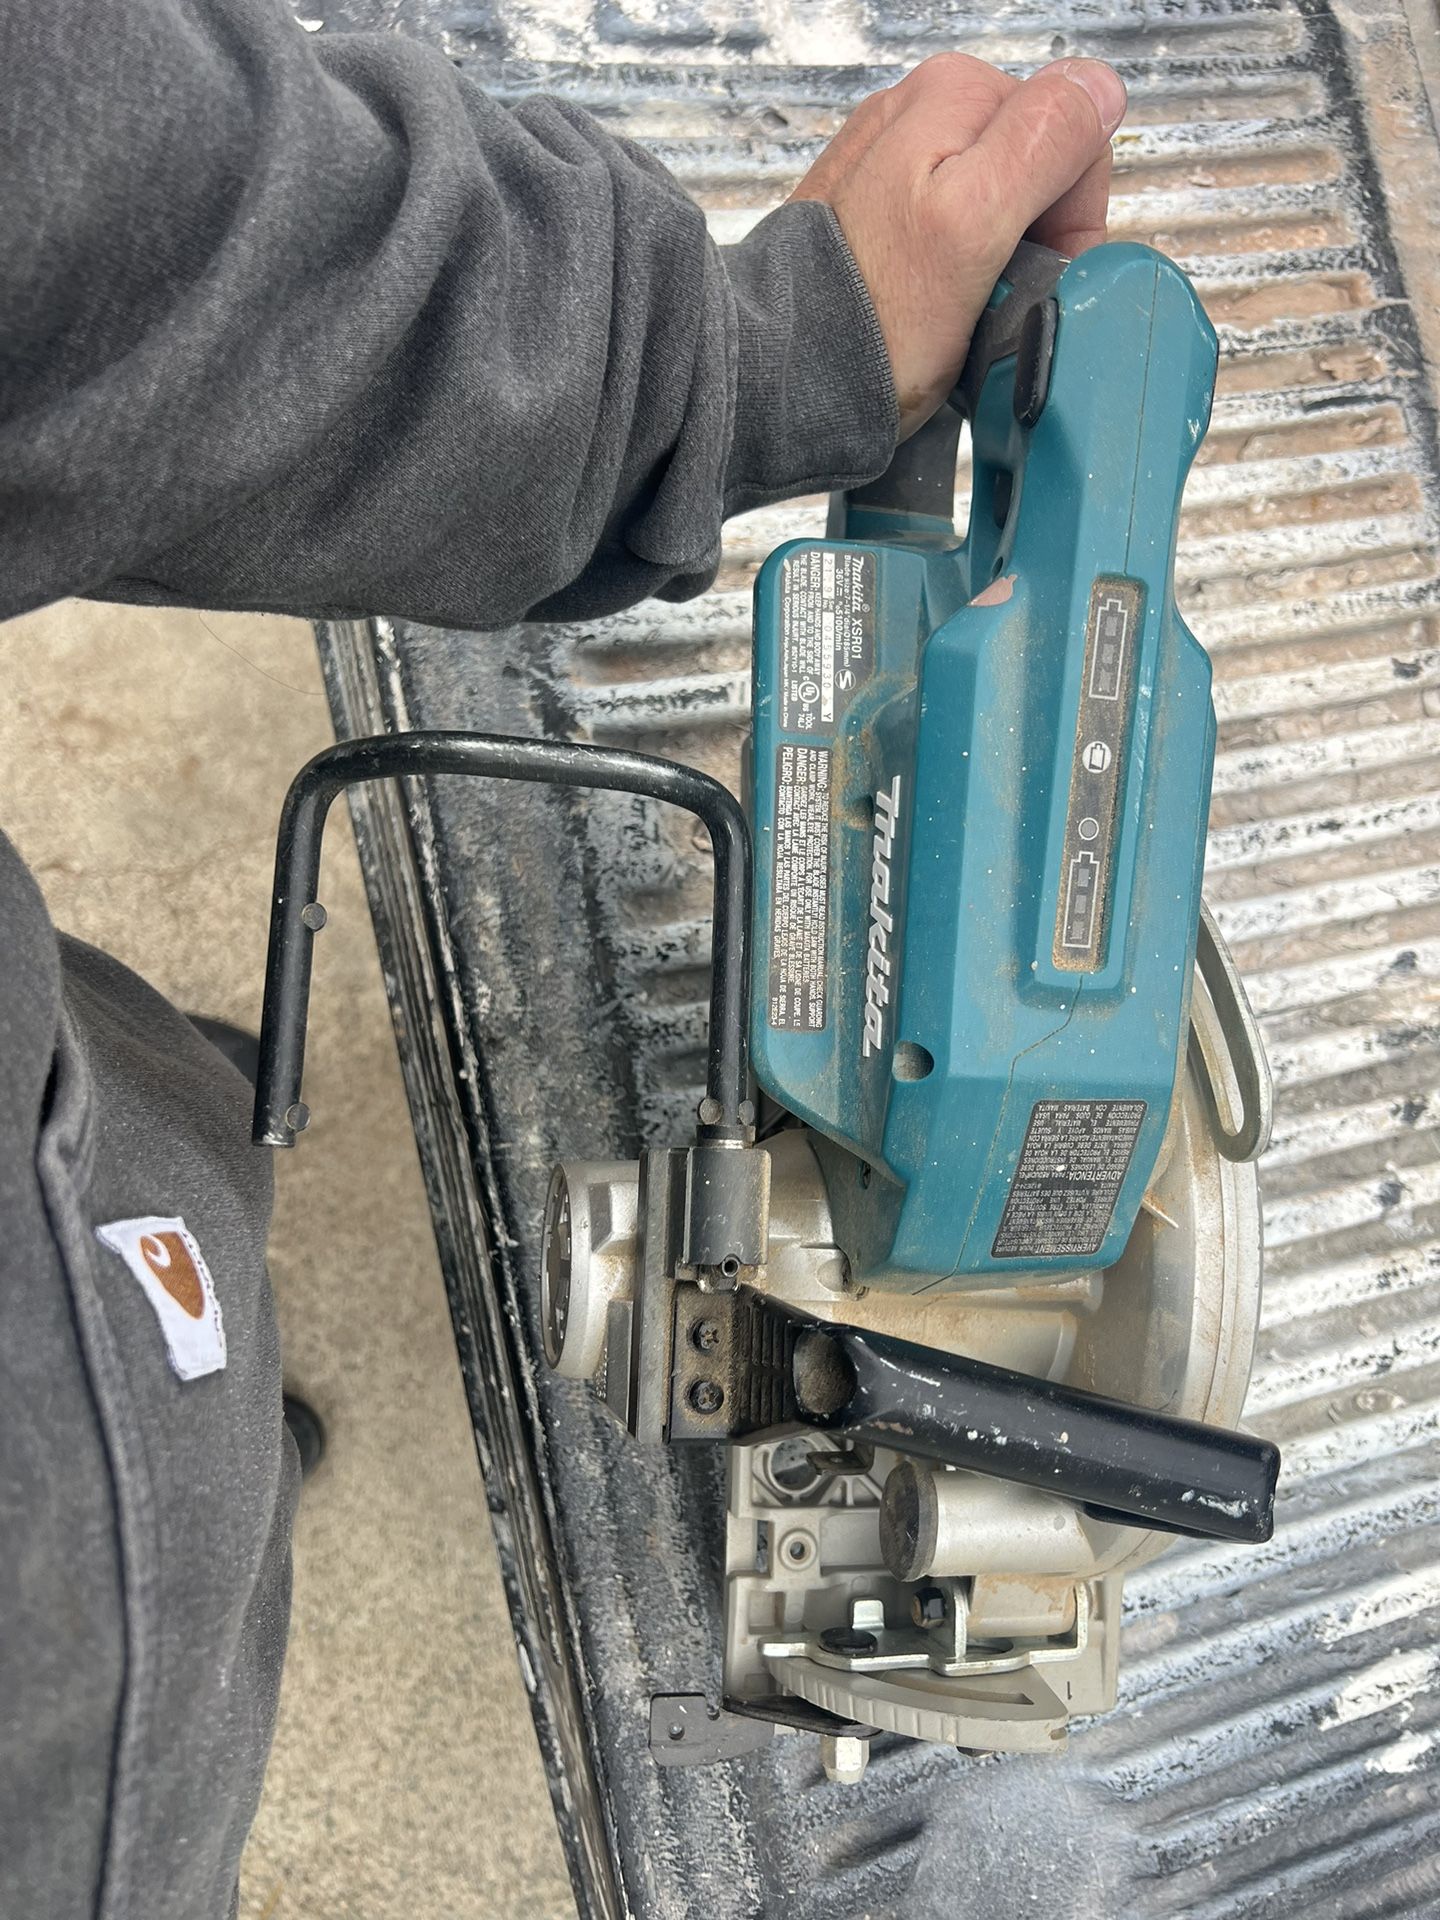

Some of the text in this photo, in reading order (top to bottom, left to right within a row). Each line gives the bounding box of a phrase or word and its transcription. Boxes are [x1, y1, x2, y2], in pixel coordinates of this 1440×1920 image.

[810, 552, 820, 591] DANGER:
[783, 597, 791, 635] Corporation
[807, 626, 813, 634] TO
[851, 618, 862, 659] XSR01
[806, 667, 812, 675] OF
[782, 747, 793, 785] PELIGRO:
[797, 748, 807, 785] DANGER:
[817, 751, 828, 791] WARNING:
[799, 839, 805, 847] ET
[791, 889, 796, 897] UN
[790, 922, 795, 930] DE
[781, 949, 787, 957] DE
[1067, 1171, 1122, 1180] ADVERTENCIA:
[1035, 1243, 1097, 1253] AVERTISSEMENT:
